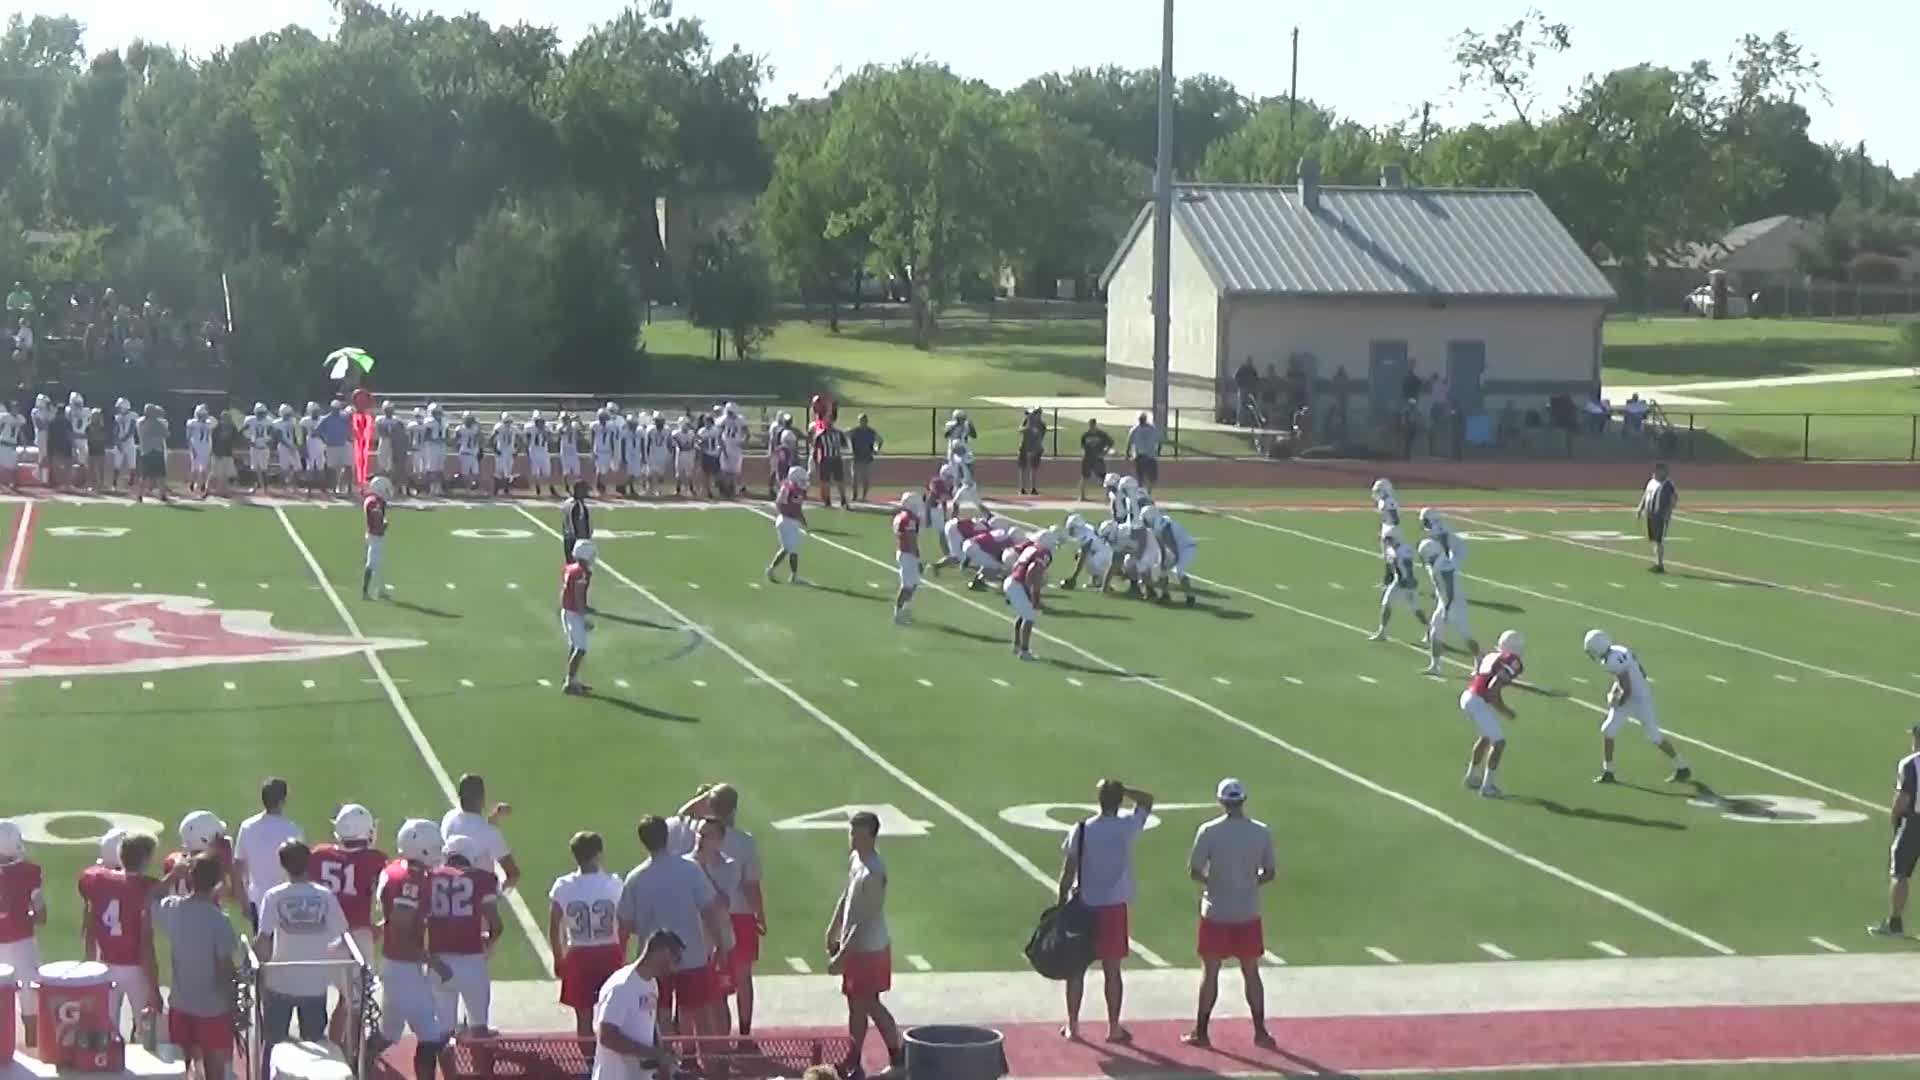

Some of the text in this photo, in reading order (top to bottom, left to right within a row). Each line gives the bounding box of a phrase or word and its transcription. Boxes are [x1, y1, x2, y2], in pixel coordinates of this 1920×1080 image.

[771, 803, 935, 836] 4
[1686, 794, 1869, 824] 3
[320, 860, 358, 897] 51
[430, 877, 475, 917] 62
[101, 898, 123, 937] 4
[58, 1001, 81, 1024] G
[94, 1053, 108, 1067] G
